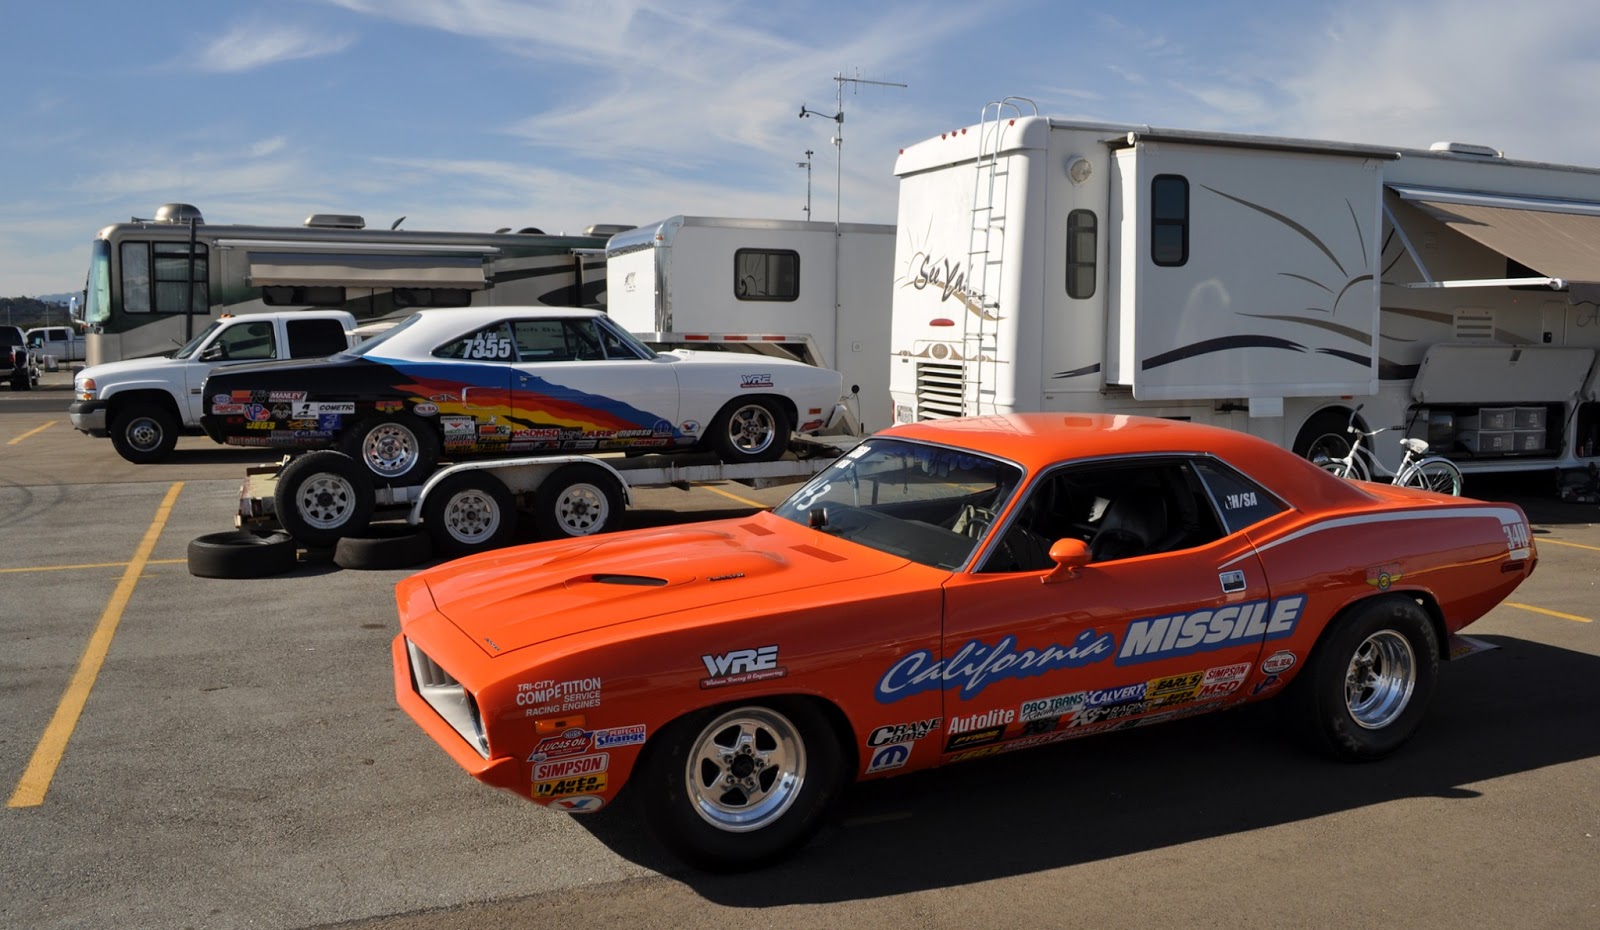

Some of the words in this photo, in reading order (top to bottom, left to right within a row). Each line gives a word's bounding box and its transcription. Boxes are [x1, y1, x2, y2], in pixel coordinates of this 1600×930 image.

[914, 254, 940, 290] See
[462, 339, 511, 359] 7355
[741, 374, 771, 384] WRE
[618, 429, 652, 437] MOROSO
[1119, 597, 1303, 659] MISSILE
[702, 645, 779, 677] WRE
[879, 632, 1111, 693] California
[1206, 665, 1248, 680] SIMPSON
[516, 677, 602, 706] COMPETITION
[517, 680, 555, 692] TRI-CITY
[1089, 684, 1142, 705] CALVERT
[1199, 681, 1240, 697] MSD
[563, 690, 601, 703] SERVICE
[1021, 701, 1048, 714] PRO
[1049, 693, 1084, 709] TRANS
[525, 704, 560, 717] RACING
[562, 698, 601, 712] ENGINES
[609, 726, 644, 736] PERFECTLY
[947, 709, 1015, 735] Autolite
[597, 732, 645, 746] Strange
[868, 719, 941, 747] CRANE
[538, 739, 569, 752] LUCAS
[571, 737, 587, 747] OIL
[537, 757, 603, 779] SIMPSON
[550, 783, 605, 796] Meter
[556, 777, 598, 788] Auto
